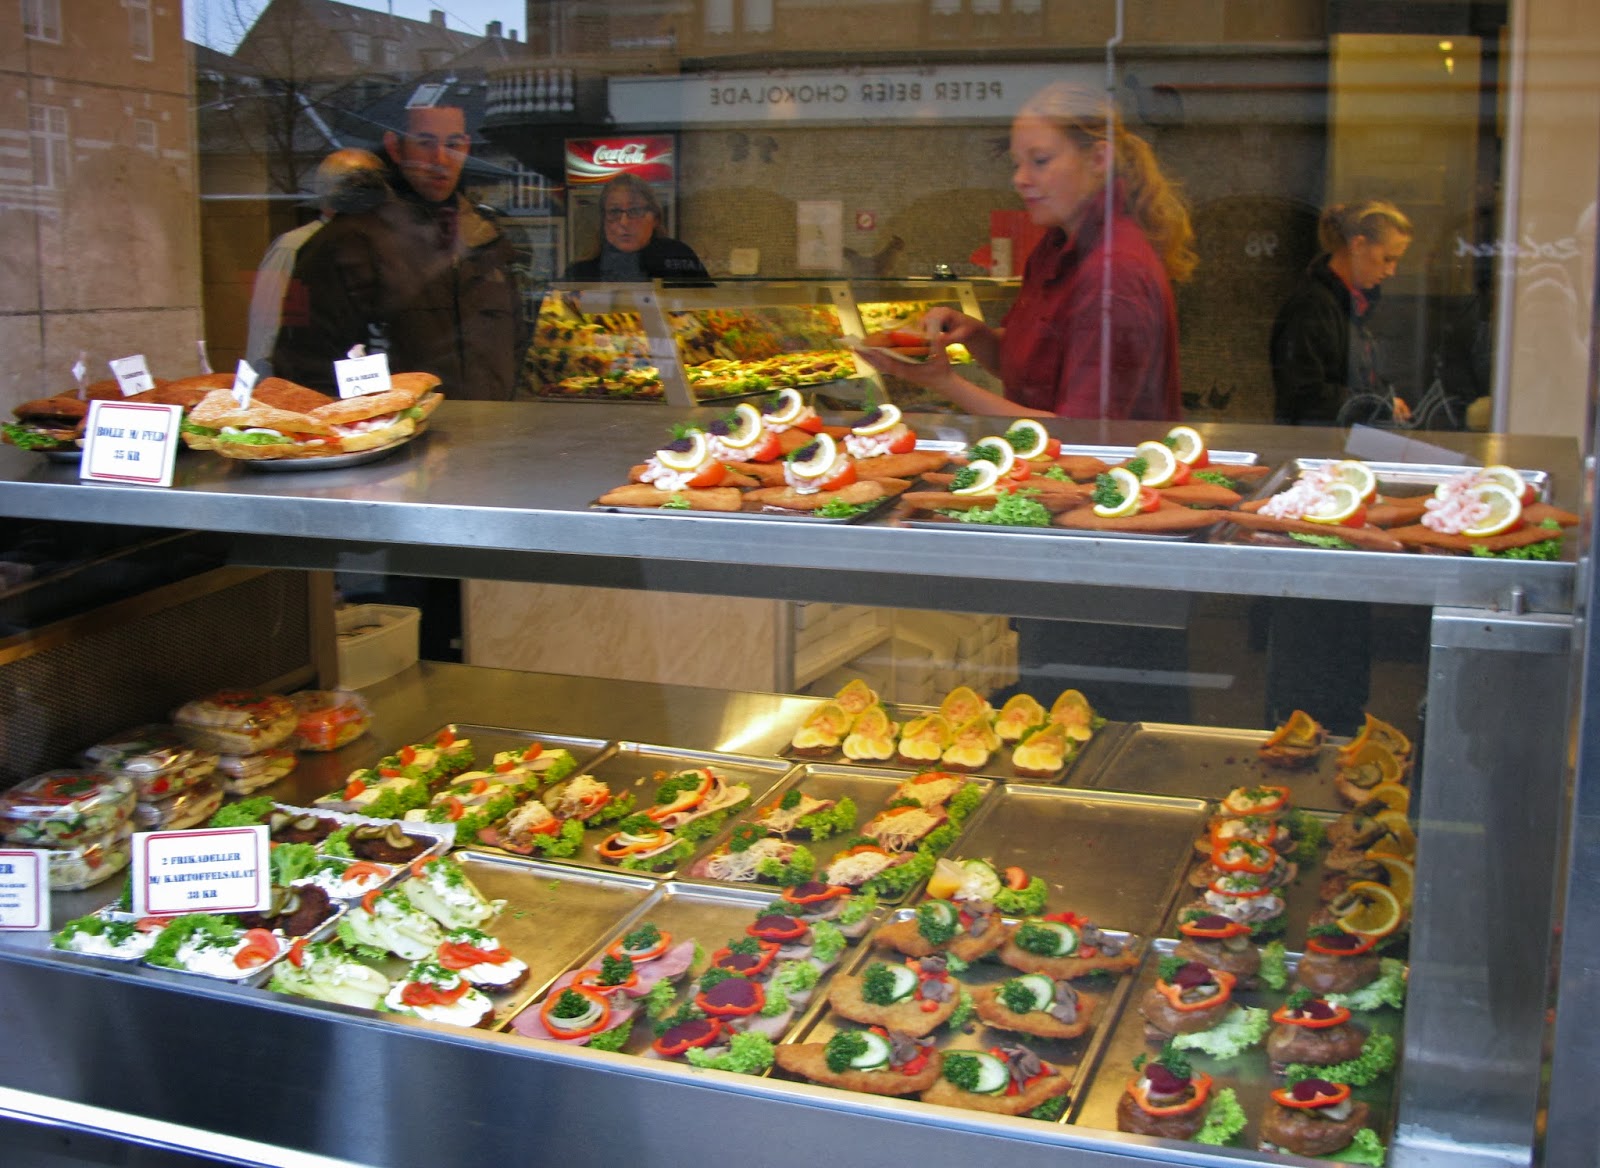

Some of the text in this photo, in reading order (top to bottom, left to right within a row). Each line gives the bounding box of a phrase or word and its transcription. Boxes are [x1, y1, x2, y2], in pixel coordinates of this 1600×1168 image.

[171, 852, 241, 865] FRIKADELLER
[164, 869, 256, 883] KARTOFFELSALAT
[202, 889, 218, 899] KR
